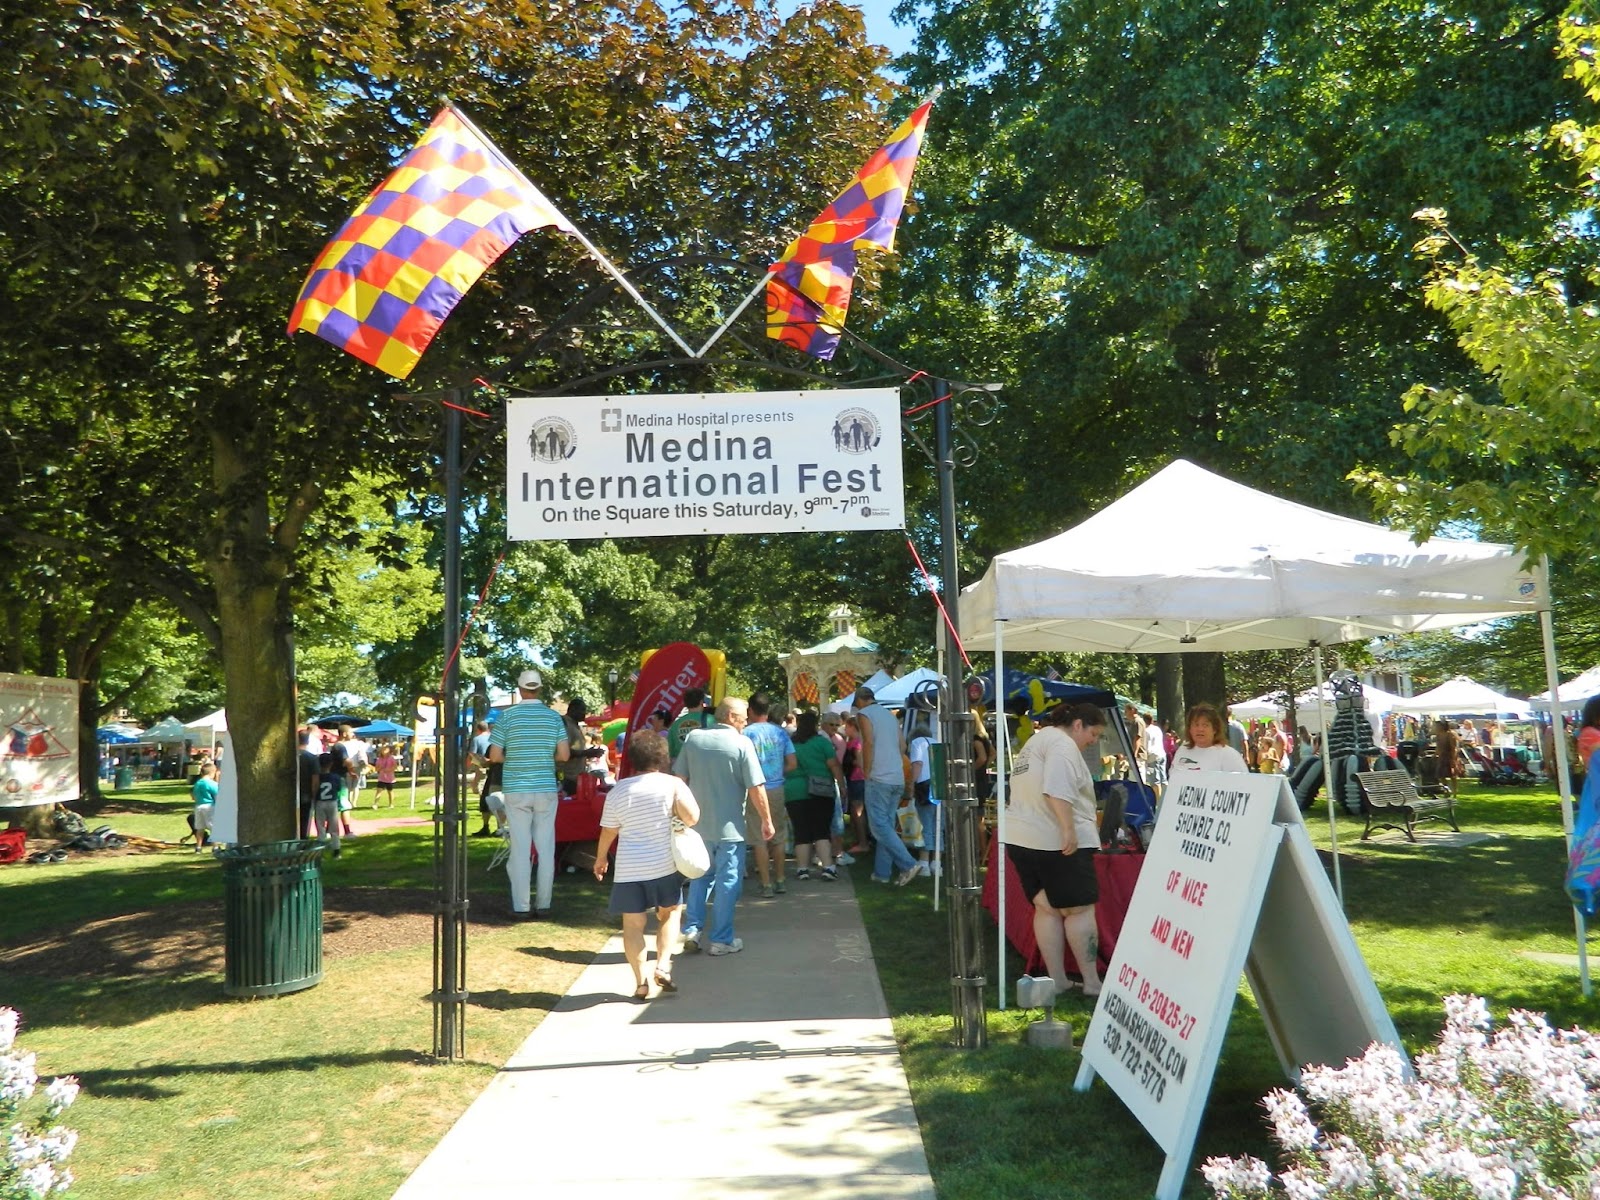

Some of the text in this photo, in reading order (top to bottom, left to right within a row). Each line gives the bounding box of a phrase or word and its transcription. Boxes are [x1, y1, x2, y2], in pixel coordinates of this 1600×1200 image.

[626, 411, 794, 428] Medina Hospital presents
[626, 430, 772, 463] Medina
[522, 463, 882, 502] International Fest
[541, 507, 568, 523] On
[572, 506, 601, 521] the
[605, 504, 670, 524] Square
[674, 502, 708, 518] this
[713, 500, 798, 519] Saturday,
[320, 782, 333, 800] 2
[1177, 785, 1251, 816] MEDINA COUNTY
[1175, 812, 1231, 846] SHOWBIZ CO.
[1180, 839, 1216, 862] PRESENTS
[1166, 870, 1208, 907] OF MICE
[1150, 914, 1194, 960] AND MEN
[1118, 963, 1138, 992] OCT
[1103, 990, 1188, 1084] MEDINASHOWBIZ.COM
[1103, 1023, 1167, 1103] 330-722-5776
